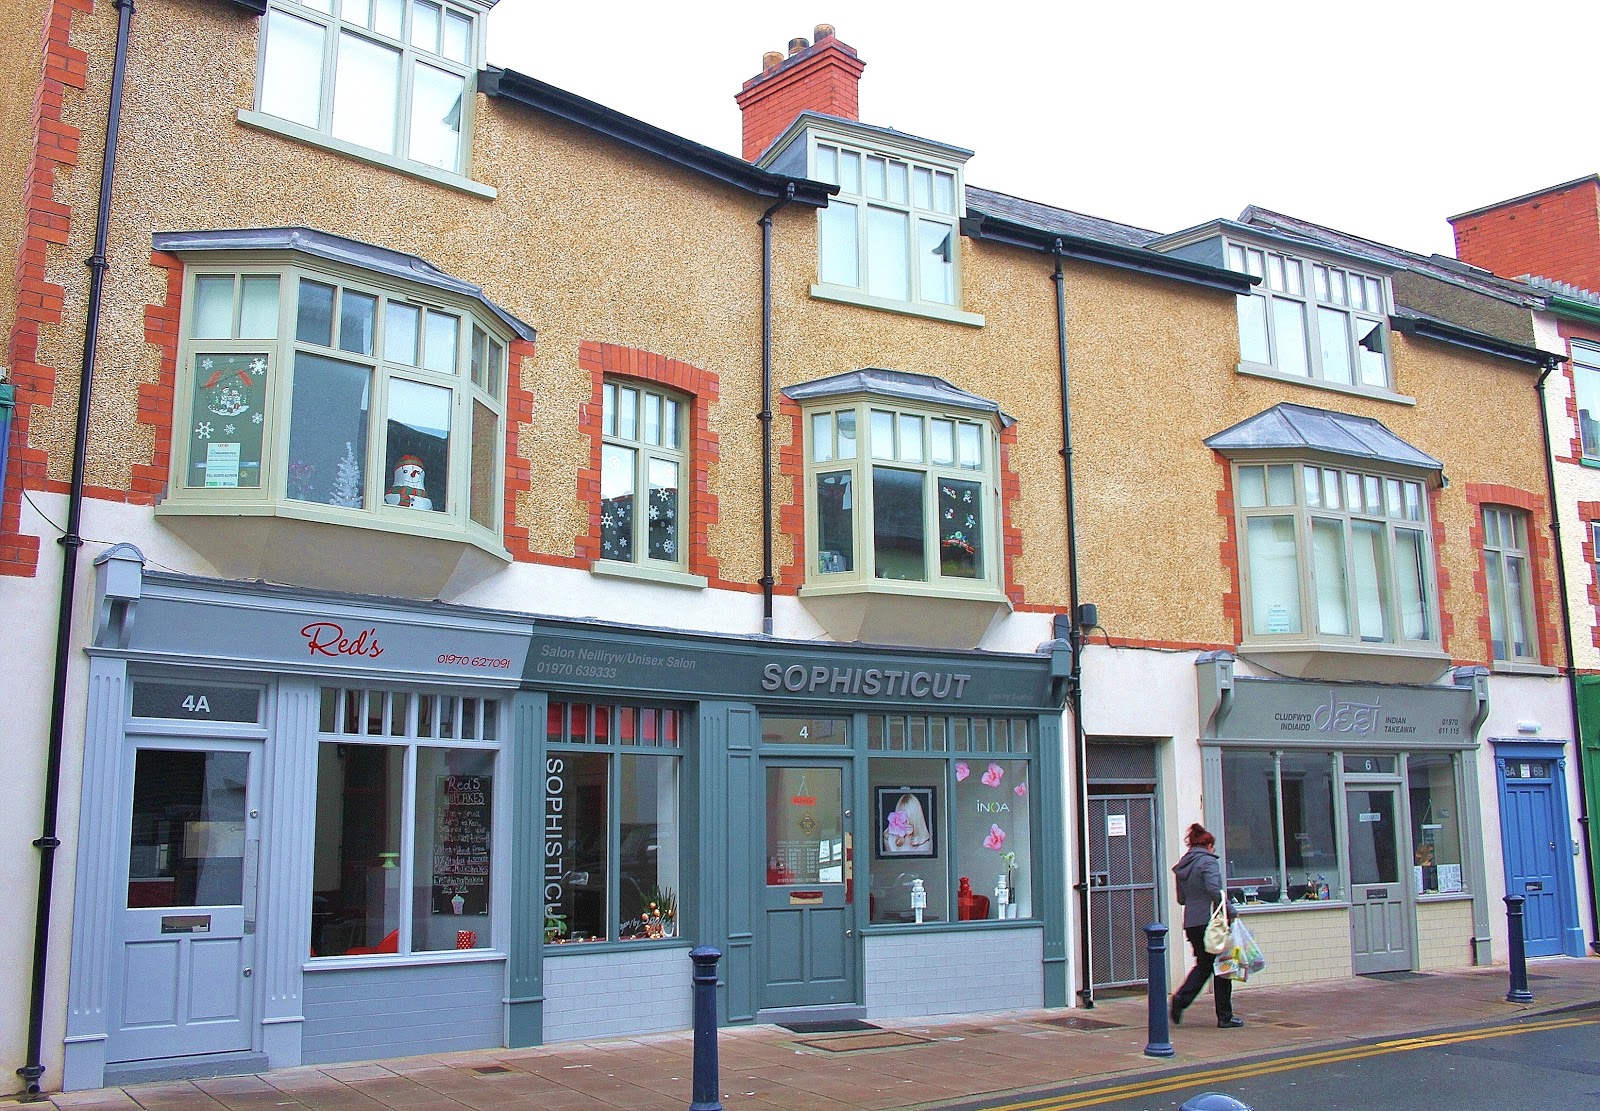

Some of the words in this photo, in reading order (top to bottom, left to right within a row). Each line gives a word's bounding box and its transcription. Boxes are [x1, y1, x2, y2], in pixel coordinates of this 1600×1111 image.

[301, 621, 384, 658] Red's
[437, 654, 469, 666] 01970
[471, 656, 511, 669] 627091
[541, 645, 575, 659] Salon
[666, 656, 696, 669] Salon
[537, 661, 573, 675] 01970
[575, 665, 617, 678] 639333
[761, 663, 972, 699] SOPHISTICUT
[181, 694, 211, 713] 4A
[1274, 712, 1312, 722] CLUDFWYD
[1385, 716, 1407, 724] INDIAN
[1441, 718, 1459, 726] 01970
[799, 725, 809, 739] 4
[1280, 722, 1311, 731] INDIAIDD
[1384, 725, 1417, 734] TAKEAWAY
[1438, 727, 1448, 735] 611
[1449, 727, 1460, 735] 115
[1365, 759, 1372, 771] 6
[1505, 766, 1516, 777] 6A
[1533, 766, 1544, 777] 6B
[544, 758, 564, 936] SOPHISTICUT
